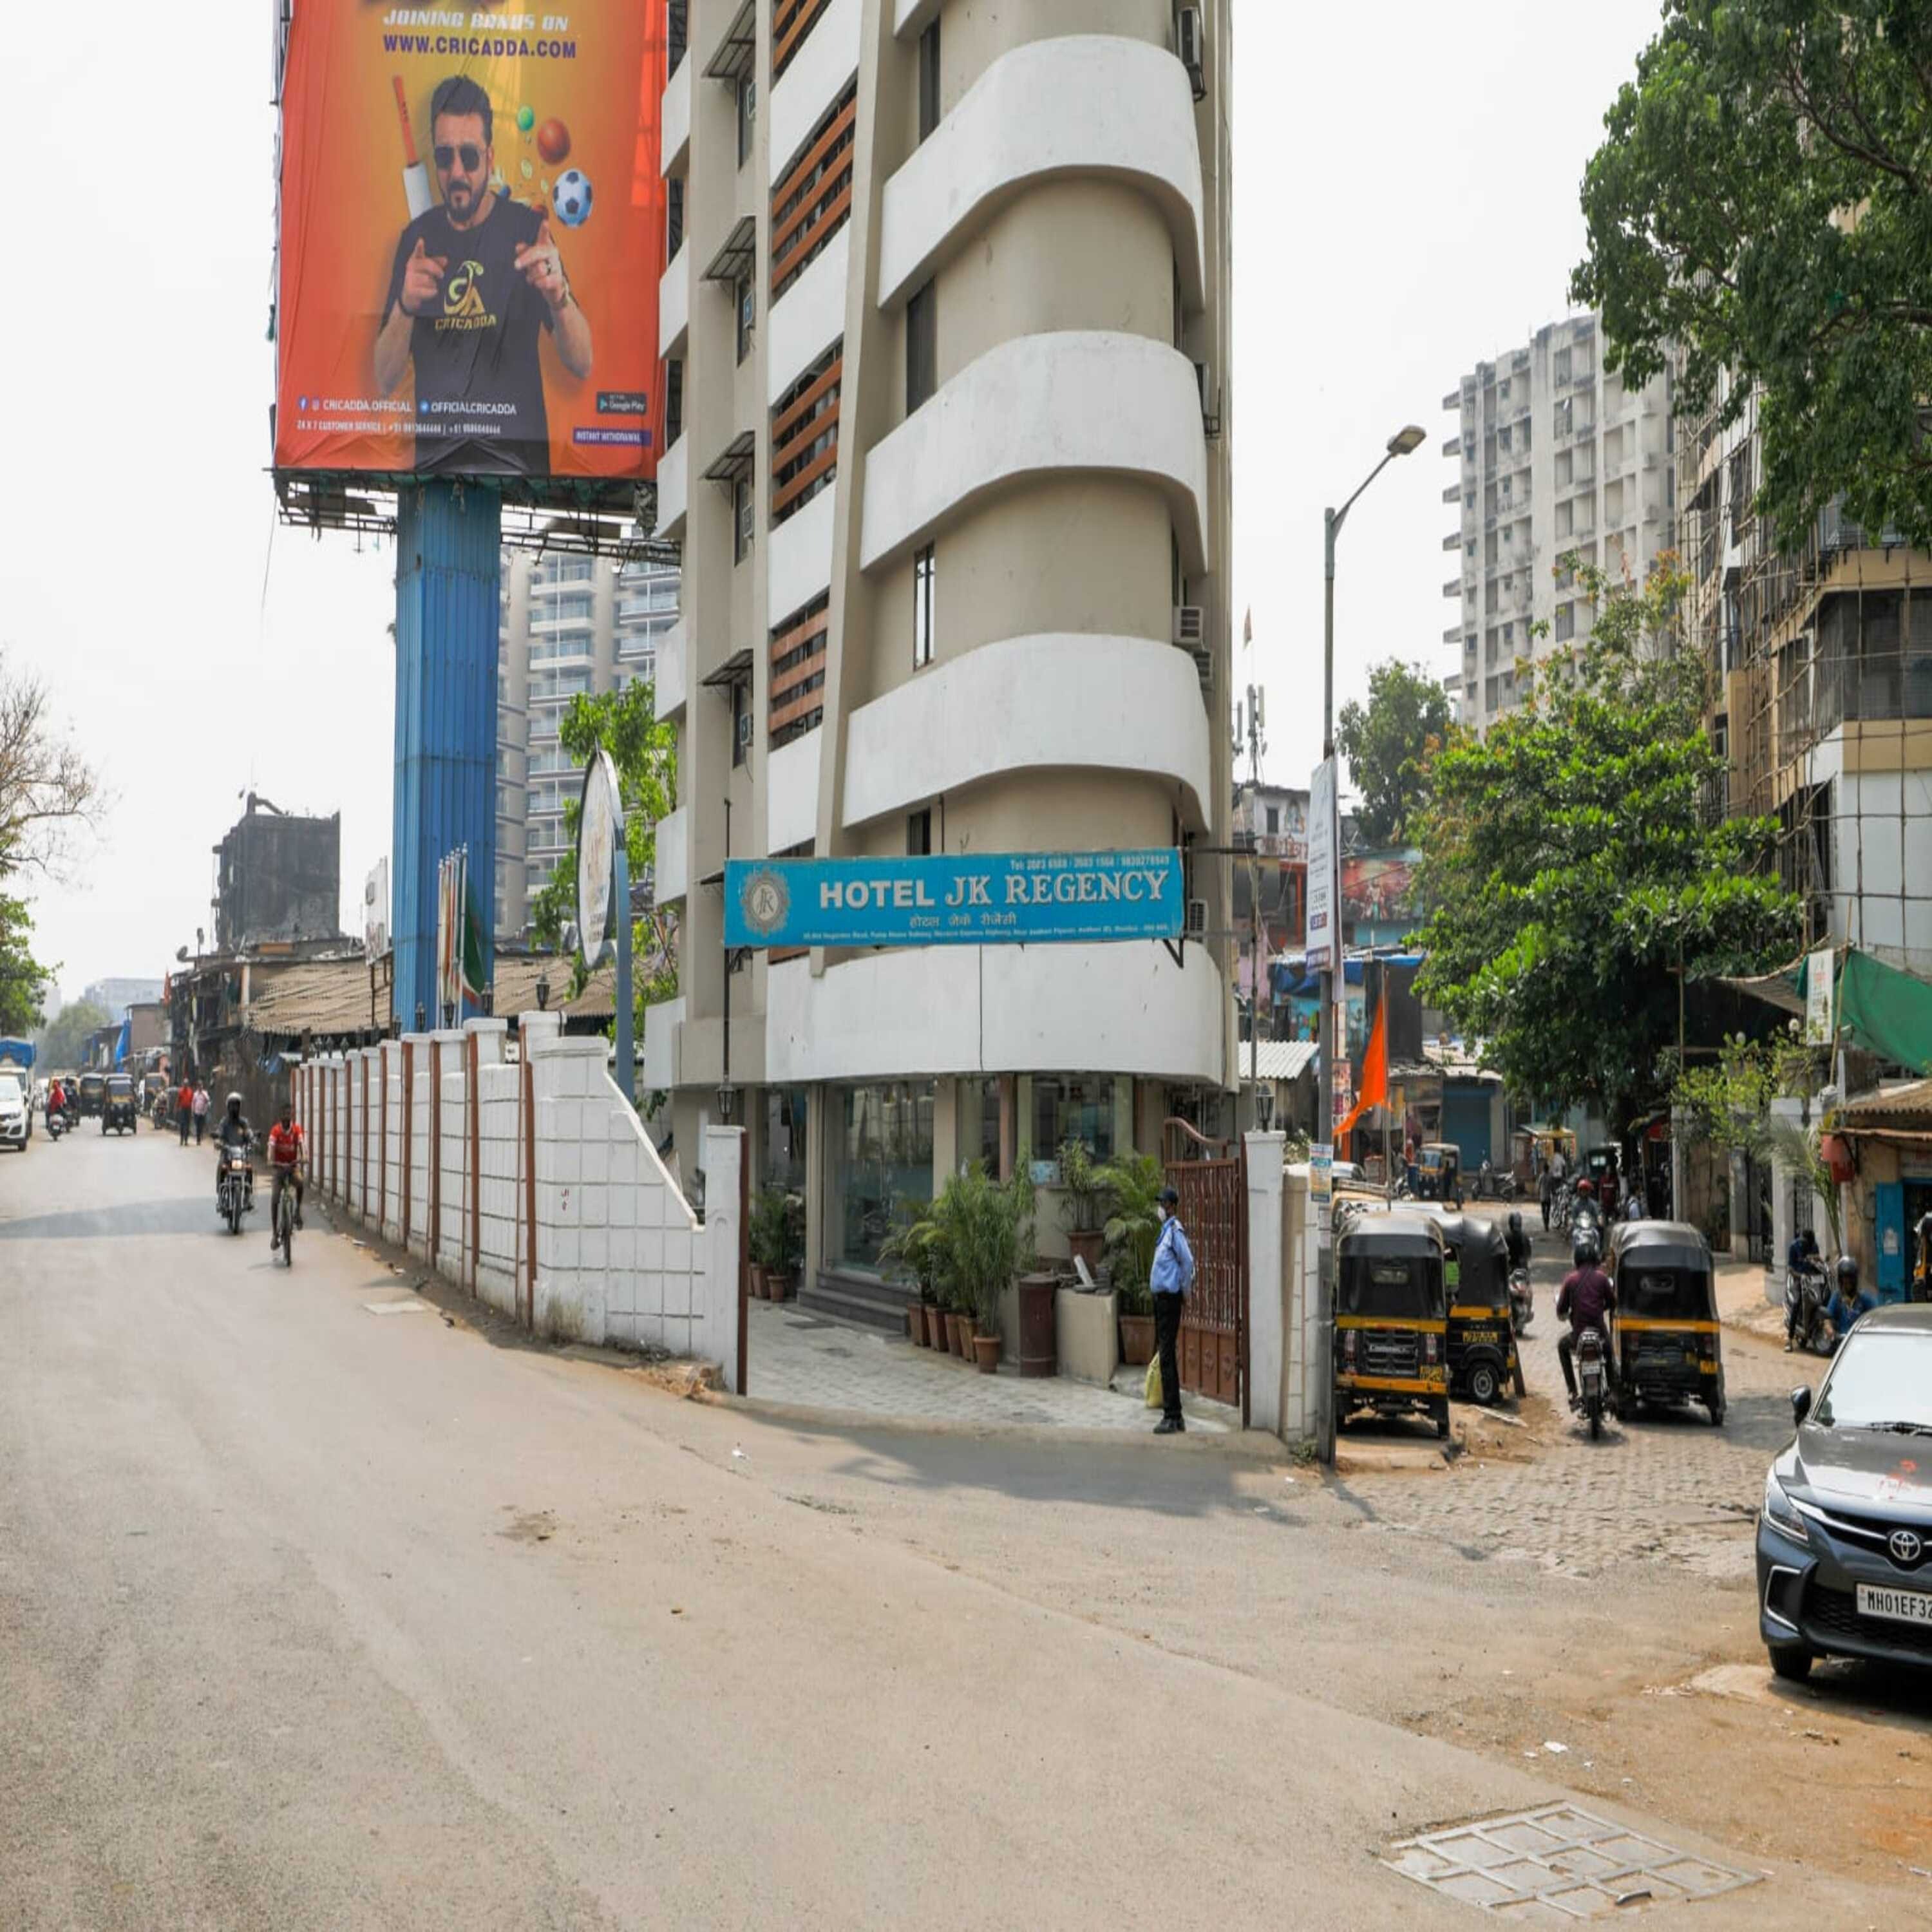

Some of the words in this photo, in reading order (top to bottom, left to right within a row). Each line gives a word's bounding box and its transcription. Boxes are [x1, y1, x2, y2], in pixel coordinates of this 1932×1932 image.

[383, 10, 464, 28] JOINING
[470, 13, 535, 31] BONUS
[542, 15, 568, 31] ON
[383, 35, 576, 58] WWW.CRICADDA.COM
[431, 401, 517, 414] OFFICIALCRICADDA
[820, 879, 936, 909] HOTEL
[944, 874, 992, 907] JK
[1004, 869, 1169, 904] REGENCY
